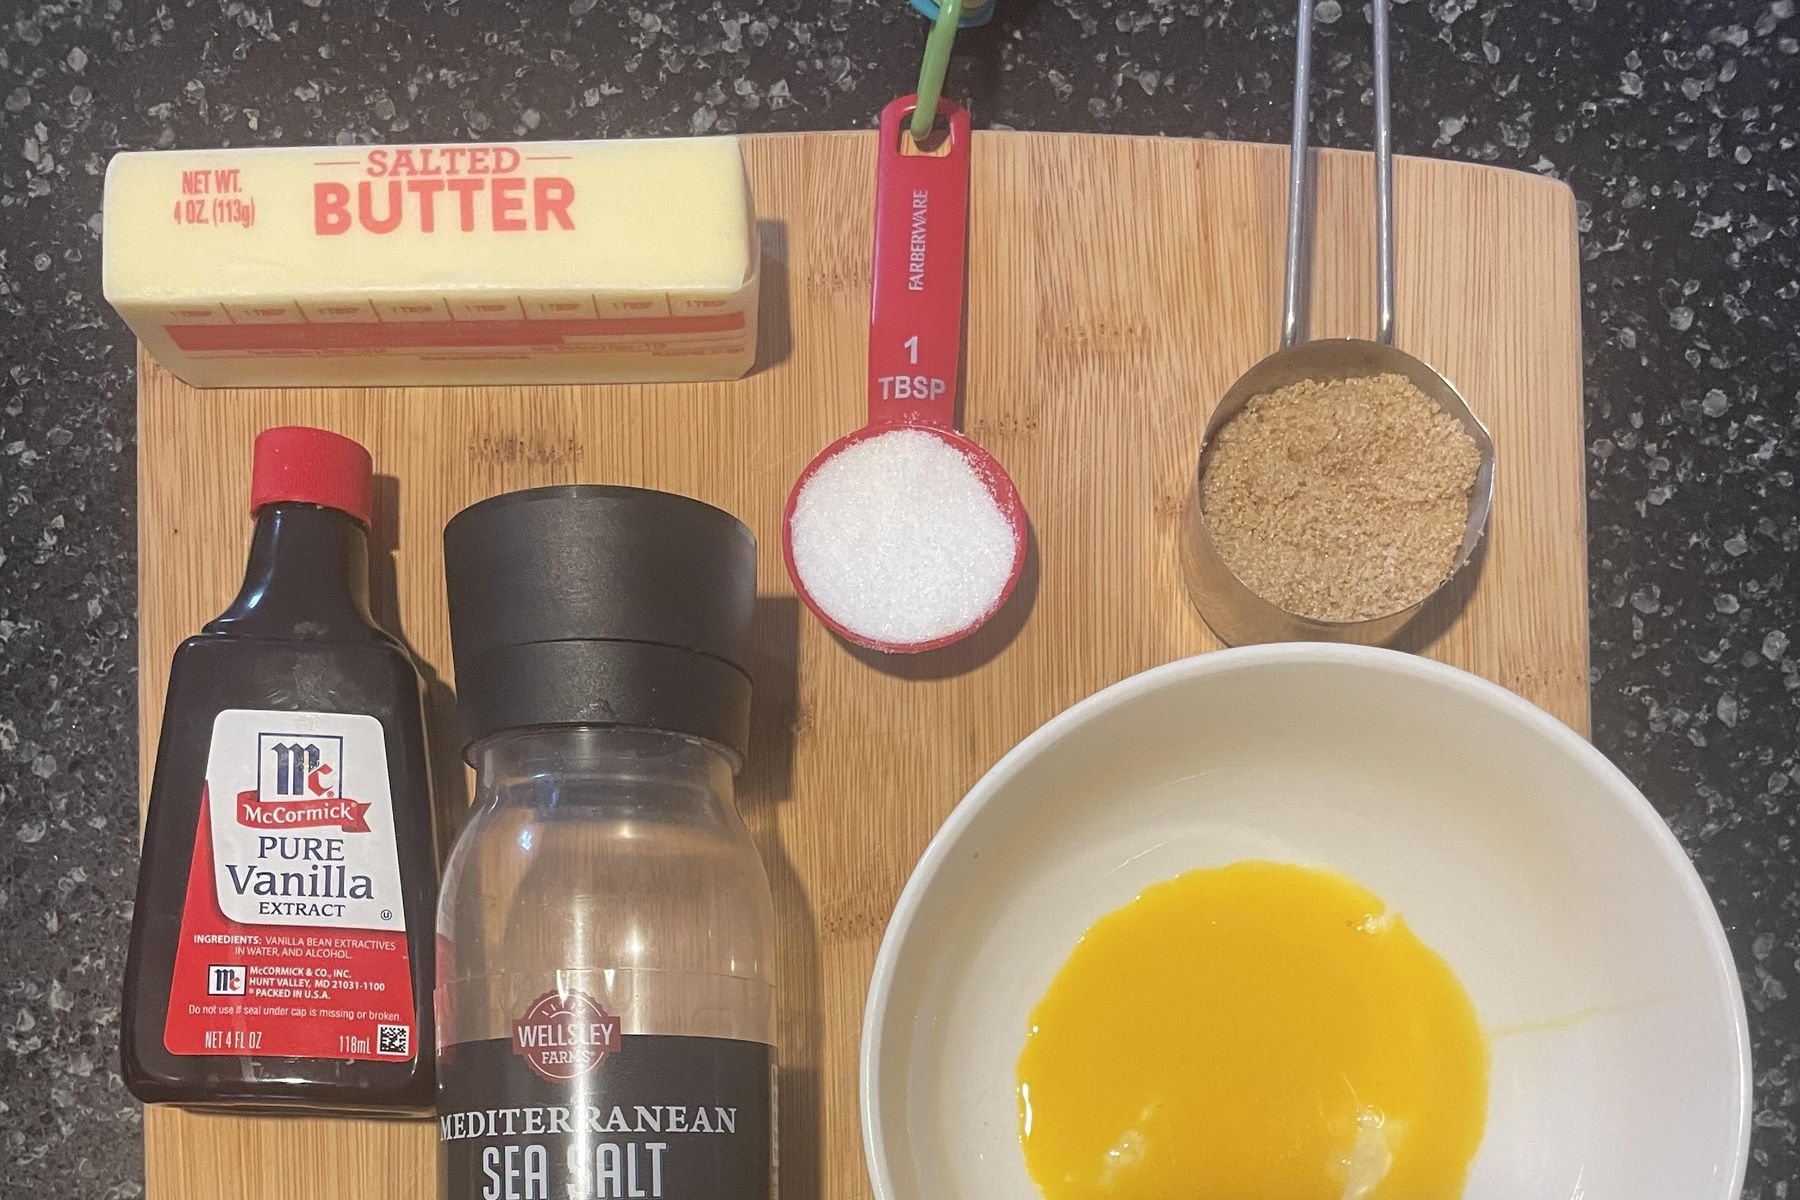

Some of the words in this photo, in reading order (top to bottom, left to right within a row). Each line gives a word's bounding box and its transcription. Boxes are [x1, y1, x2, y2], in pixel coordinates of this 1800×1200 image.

[366, 147, 521, 177] SALTED
[182, 170, 211, 195] NET
[215, 169, 242, 193] WT.
[173, 200, 182, 225] 4
[186, 199, 209, 224] OZ.
[212, 195, 255, 228] (113g)
[314, 177, 576, 236] BUTTER
[908, 190, 928, 291] FARBERWARE
[903, 336, 919, 364] 1
[878, 375, 946, 401] TBSP
[243, 803, 354, 825] McCormick
[257, 836, 345, 861] PURE
[225, 864, 375, 900] Vanilla
[259, 901, 346, 917] EXTRACT
[193, 934, 262, 945] INGREDIENTS:
[265, 936, 305, 946] VANILLA
[306, 938, 332, 948] BEAN
[334, 939, 396, 951] EXTRACTIVES
[235, 947, 245, 956] IN
[246, 946, 280, 958] WATER,
[281, 948, 304, 957] AND
[304, 949, 352, 959] ALCOHOL.
[249, 977, 275, 987] HUNT
[276, 978, 311, 989] VALLEY,
[314, 979, 330, 989] MD
[332, 980, 385, 991] 21031-1100
[305, 968, 313, 977] &
[333, 969, 352, 978] INC.
[255, 988, 291, 998] PACKED
[292, 989, 303, 998] IN
[304, 990, 331, 999] U.S.A.
[188, 1004, 201, 1015] Do
[202, 1005, 217, 1015] not
[219, 1007, 233, 1015] use
[236, 1005, 242, 1015] if
[243, 1005, 261, 1016] seal
[263, 1006, 288, 1016] under
[290, 1008, 307, 1018] cap
[309, 1008, 317, 1017] is
[319, 1009, 354, 1021] missing
[356, 1011, 366, 1019] or
[205, 1031, 223, 1049] NET
[225, 1031, 232, 1048] 4
[235, 1032, 246, 1049] FL
[248, 1032, 263, 1049] OZ
[339, 1035, 371, 1054] 118mL
[440, 1105, 738, 1142] MEDITERRANEAN
[566, 1142, 669, 1200] SALT
